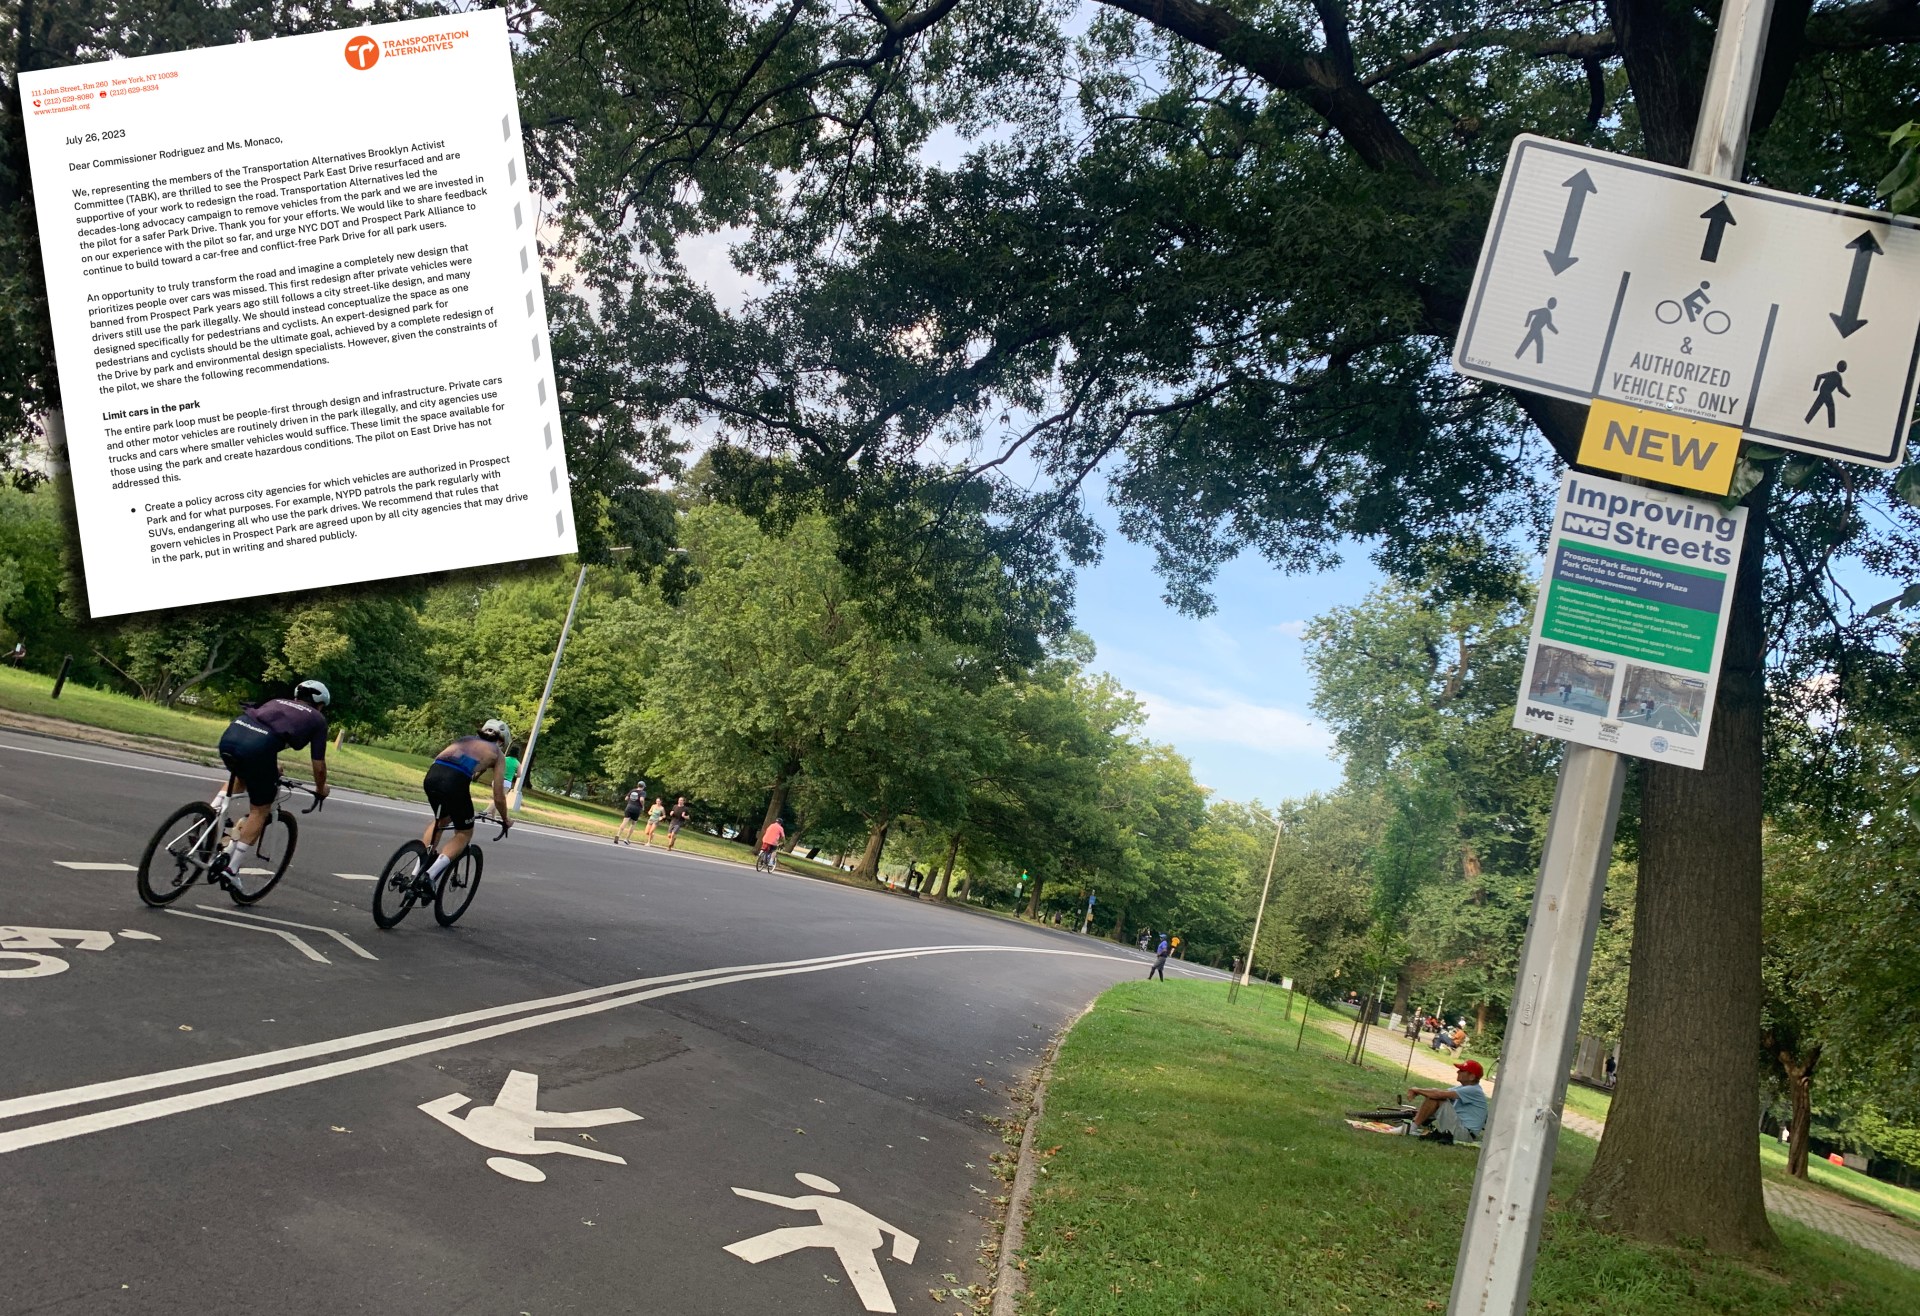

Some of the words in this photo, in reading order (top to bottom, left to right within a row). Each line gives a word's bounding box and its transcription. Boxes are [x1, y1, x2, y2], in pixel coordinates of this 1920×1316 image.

[1679, 336, 1692, 355] &
[1629, 351, 1730, 387] AUTHORIZED
[1613, 371, 1687, 404] VEHICLES
[1697, 391, 1739, 414] ONLY
[1654, 401, 1716, 420] TRSPORTATION
[1603, 420, 1719, 471] NEW
[1566, 479, 1737, 541] Improving
[1564, 514, 1607, 536] NYC
[1613, 521, 1731, 565] Streets
[1559, 569, 1574, 577] Pilot
[1561, 559, 1580, 568] Park
[1581, 563, 1605, 574] Circle
[1617, 571, 1641, 582] Grand
[1642, 577, 1664, 588] Army
[1665, 582, 1687, 592] Plaza
[1563, 550, 1599, 564] Prospect
[1600, 559, 1618, 569] Park
[1620, 563, 1638, 573] East
[1639, 567, 1663, 579] Drive,
[1525, 706, 1554, 721] NYC
